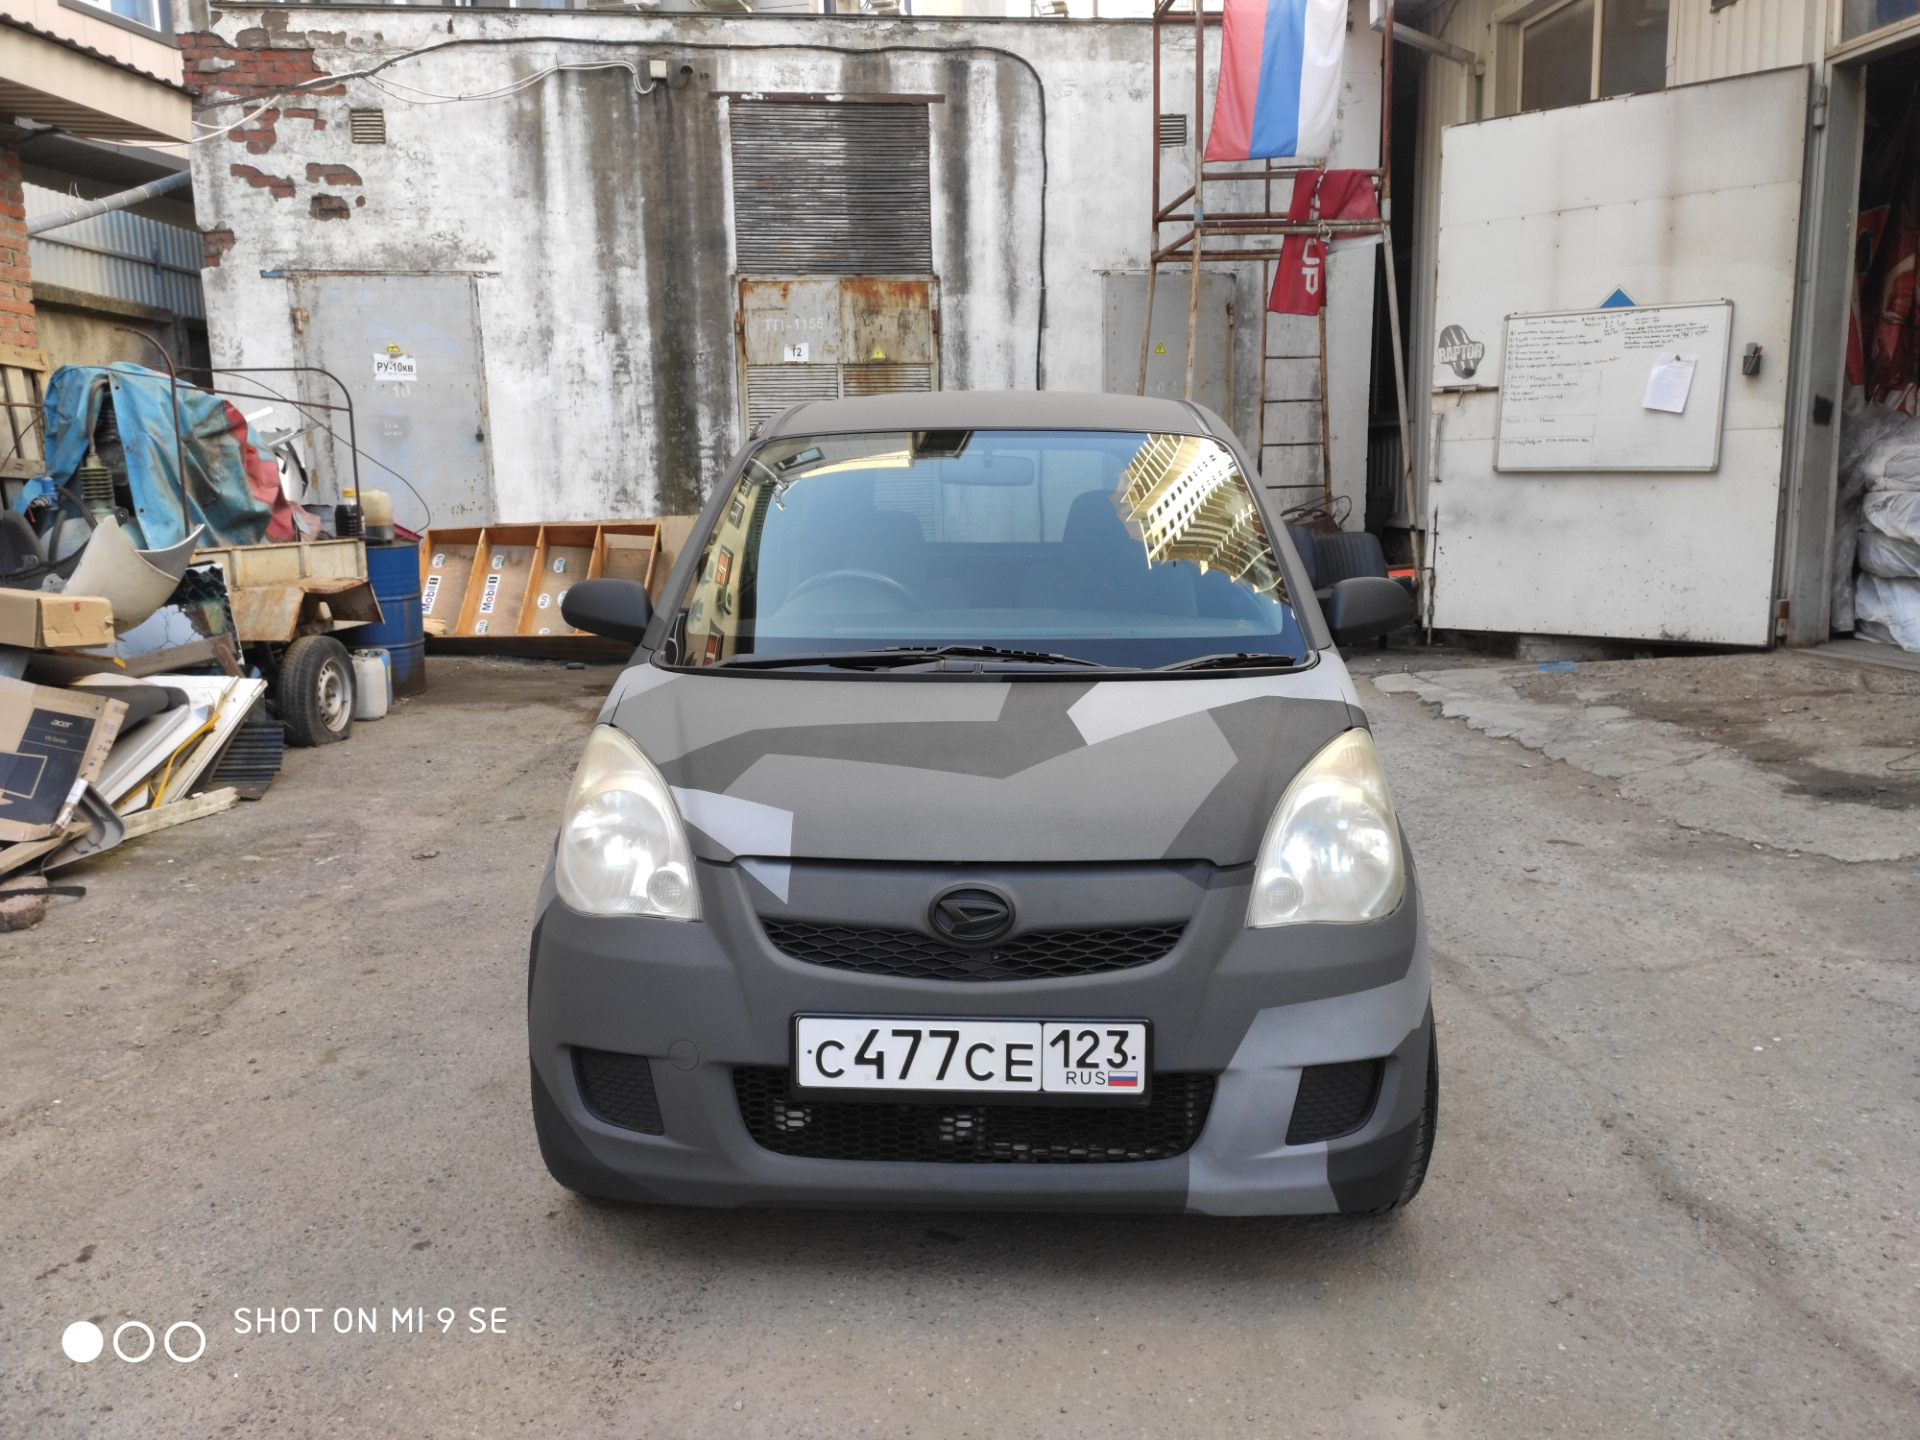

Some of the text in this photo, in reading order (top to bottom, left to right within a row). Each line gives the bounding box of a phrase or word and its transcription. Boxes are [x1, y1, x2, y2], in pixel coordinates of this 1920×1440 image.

[763, 318, 824, 332] ТП-1155
[1438, 343, 1483, 363] RAPTOR
[555, 558, 564, 571] RUS
[422, 585, 436, 612] Mobil
[482, 585, 496, 611] Mobil
[540, 595, 548, 607] RUS
[477, 621, 485, 634] RUS
[50, 719, 73, 728] acer
[1049, 1029, 1129, 1070] 123
[1065, 1071, 1106, 1086] RUS
